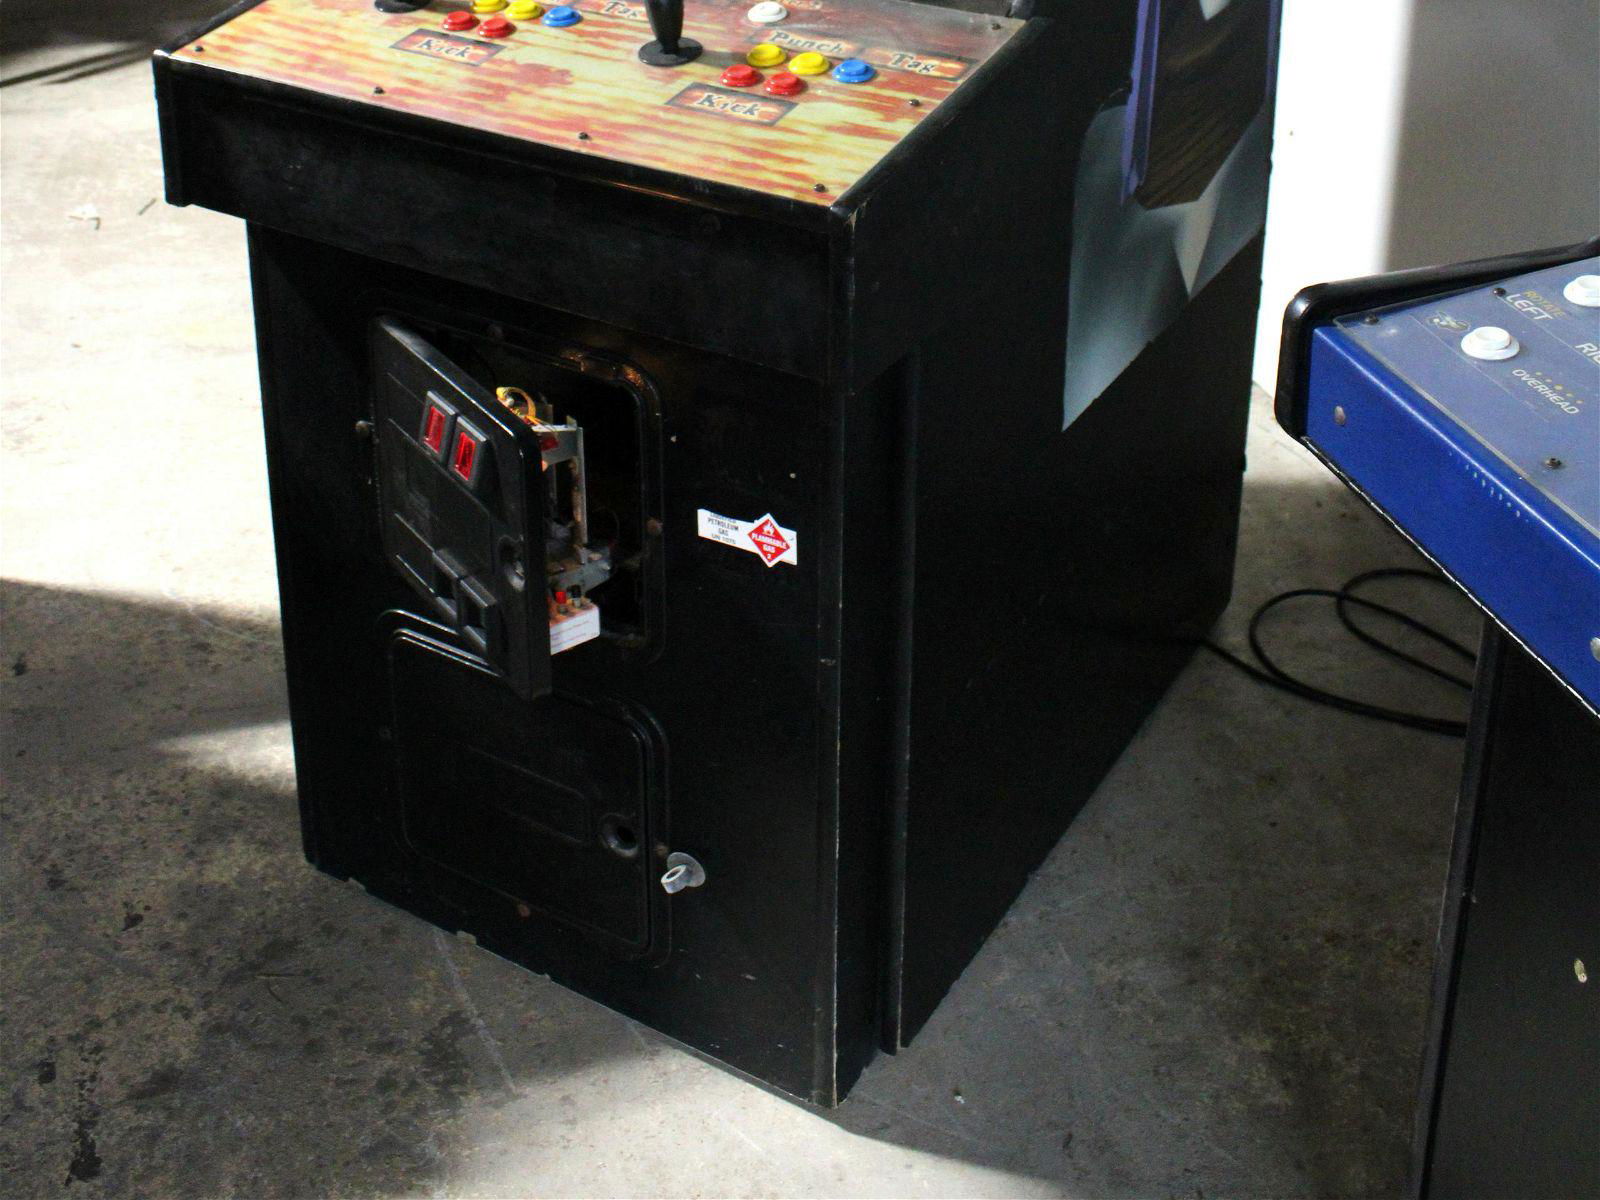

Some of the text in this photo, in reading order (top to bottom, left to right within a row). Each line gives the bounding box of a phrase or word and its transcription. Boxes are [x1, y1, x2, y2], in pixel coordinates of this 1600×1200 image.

[418, 39, 471, 58] Kick
[770, 31, 936, 74] Punch Tag
[696, 93, 760, 117] Kick
[1506, 293, 1553, 319] LEFT
[1512, 368, 1579, 414] OVERHEAD
